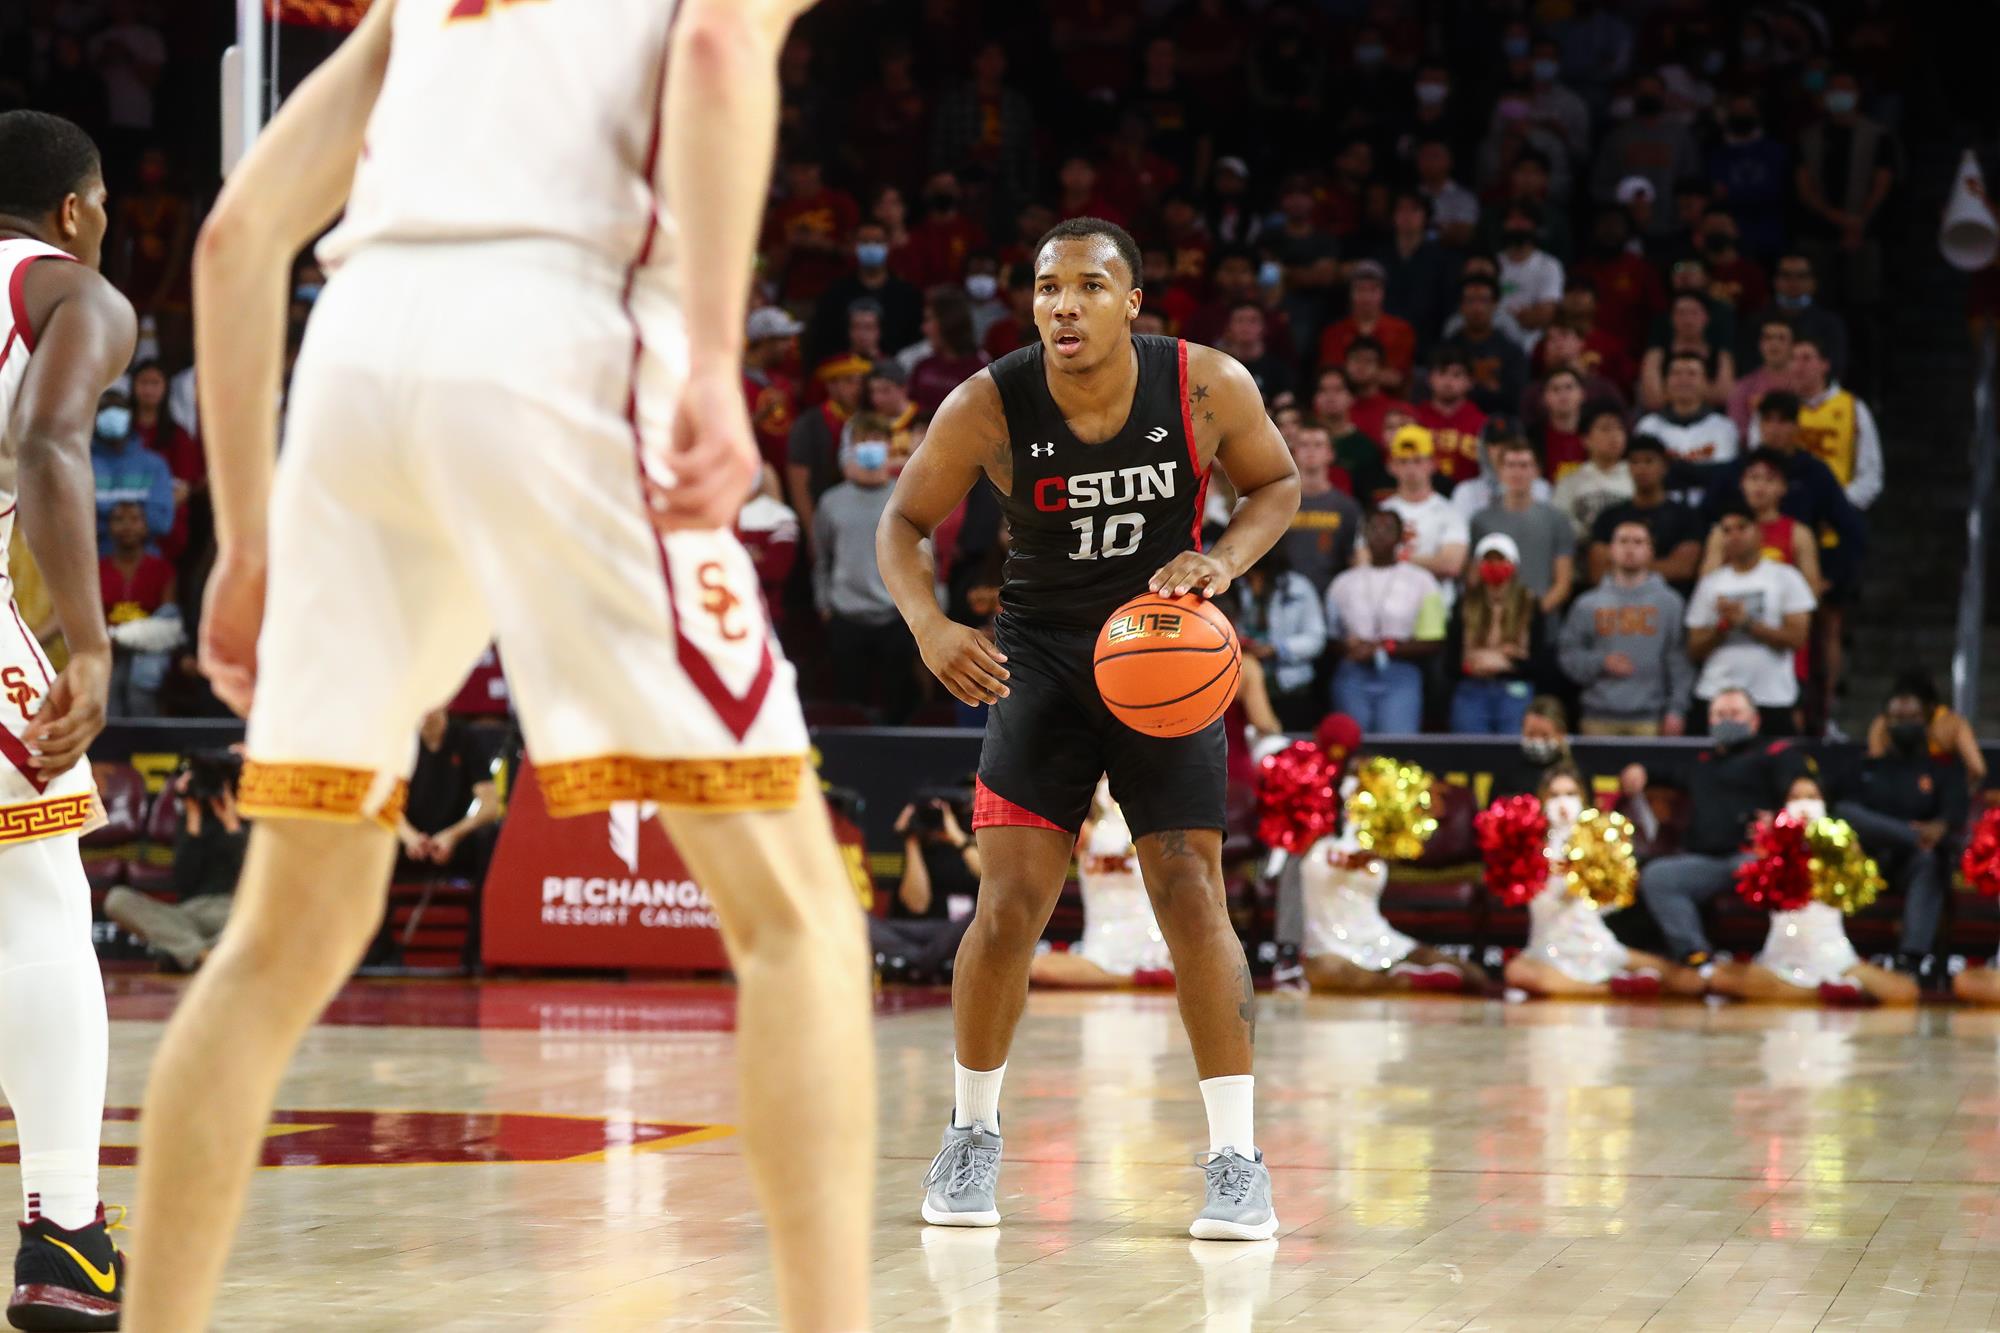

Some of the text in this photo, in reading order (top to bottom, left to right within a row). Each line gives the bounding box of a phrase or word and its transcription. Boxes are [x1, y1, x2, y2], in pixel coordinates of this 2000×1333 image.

[1033, 461, 1177, 512] CSUN
[1068, 512, 1146, 561] 10
[1108, 613, 1183, 640] ELITE
[1594, 605, 1659, 637] USC
[541, 904, 628, 926] RESORT
